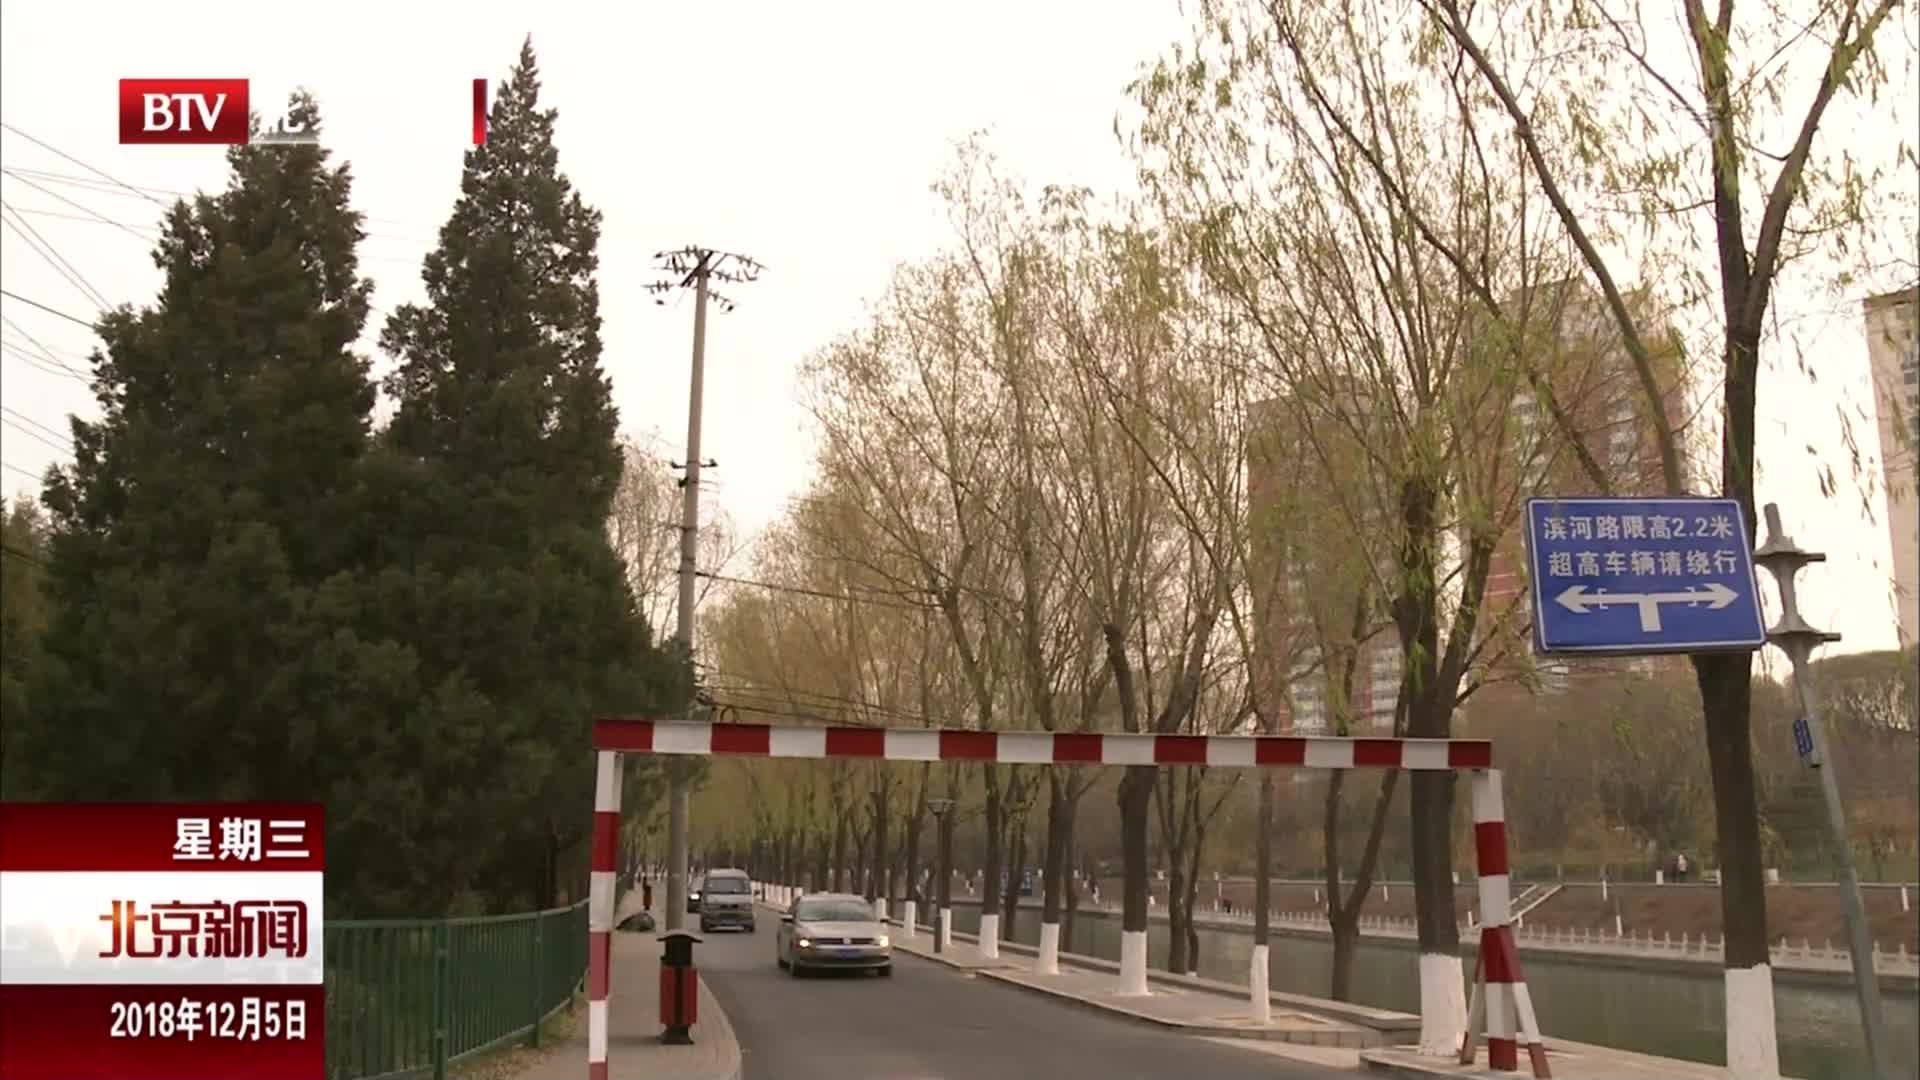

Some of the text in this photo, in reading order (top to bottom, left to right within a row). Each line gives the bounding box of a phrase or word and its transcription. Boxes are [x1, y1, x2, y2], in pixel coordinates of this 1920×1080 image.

[1543, 514, 1734, 541] 滨河路限高2.2米
[1548, 549, 1738, 577] 超高车辆请绕行
